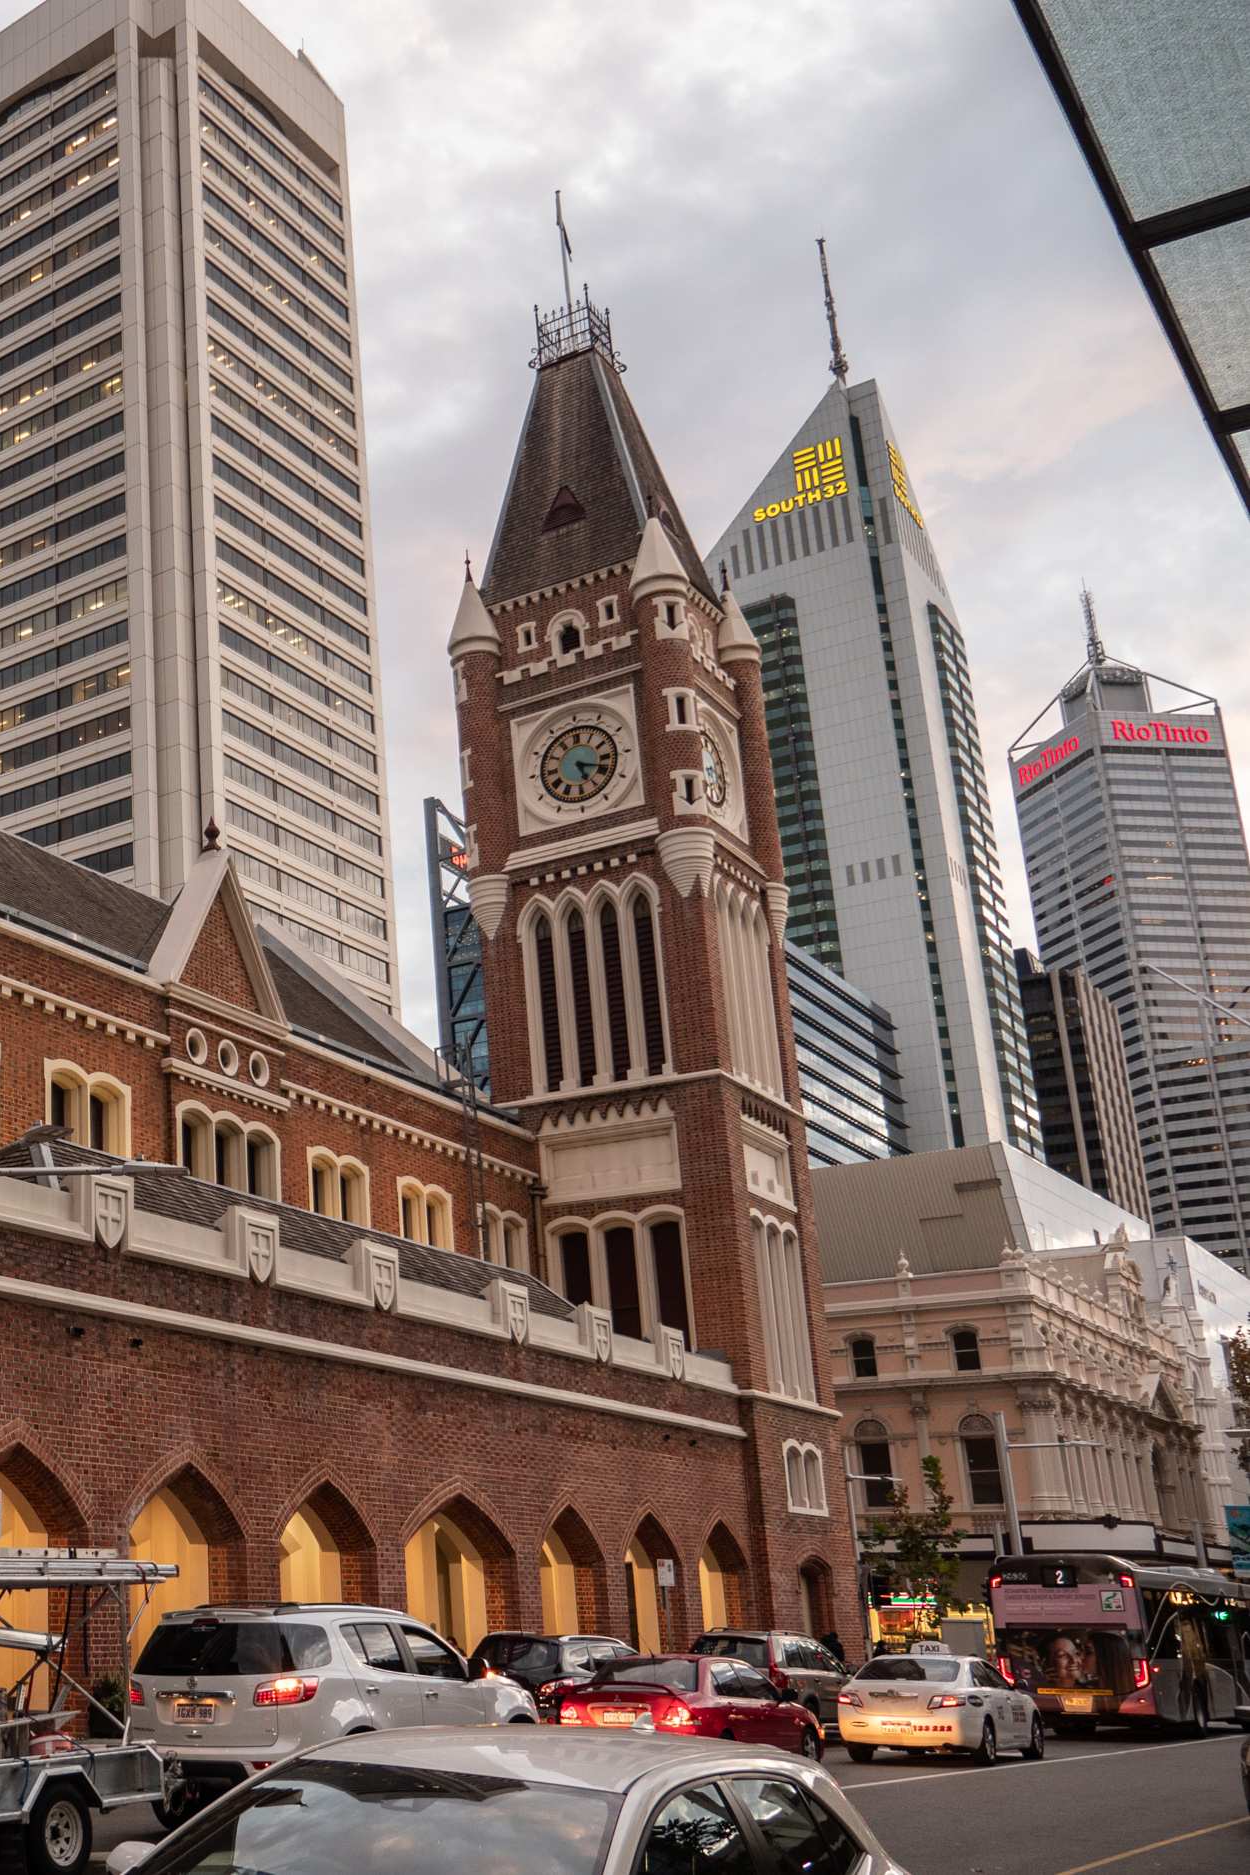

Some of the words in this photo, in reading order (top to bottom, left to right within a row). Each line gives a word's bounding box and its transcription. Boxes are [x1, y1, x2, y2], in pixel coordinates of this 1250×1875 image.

[753, 481, 848, 523] SOUTH32
[1055, 1570, 1064, 1584] 2
[918, 1644, 940, 1653] TAXI
